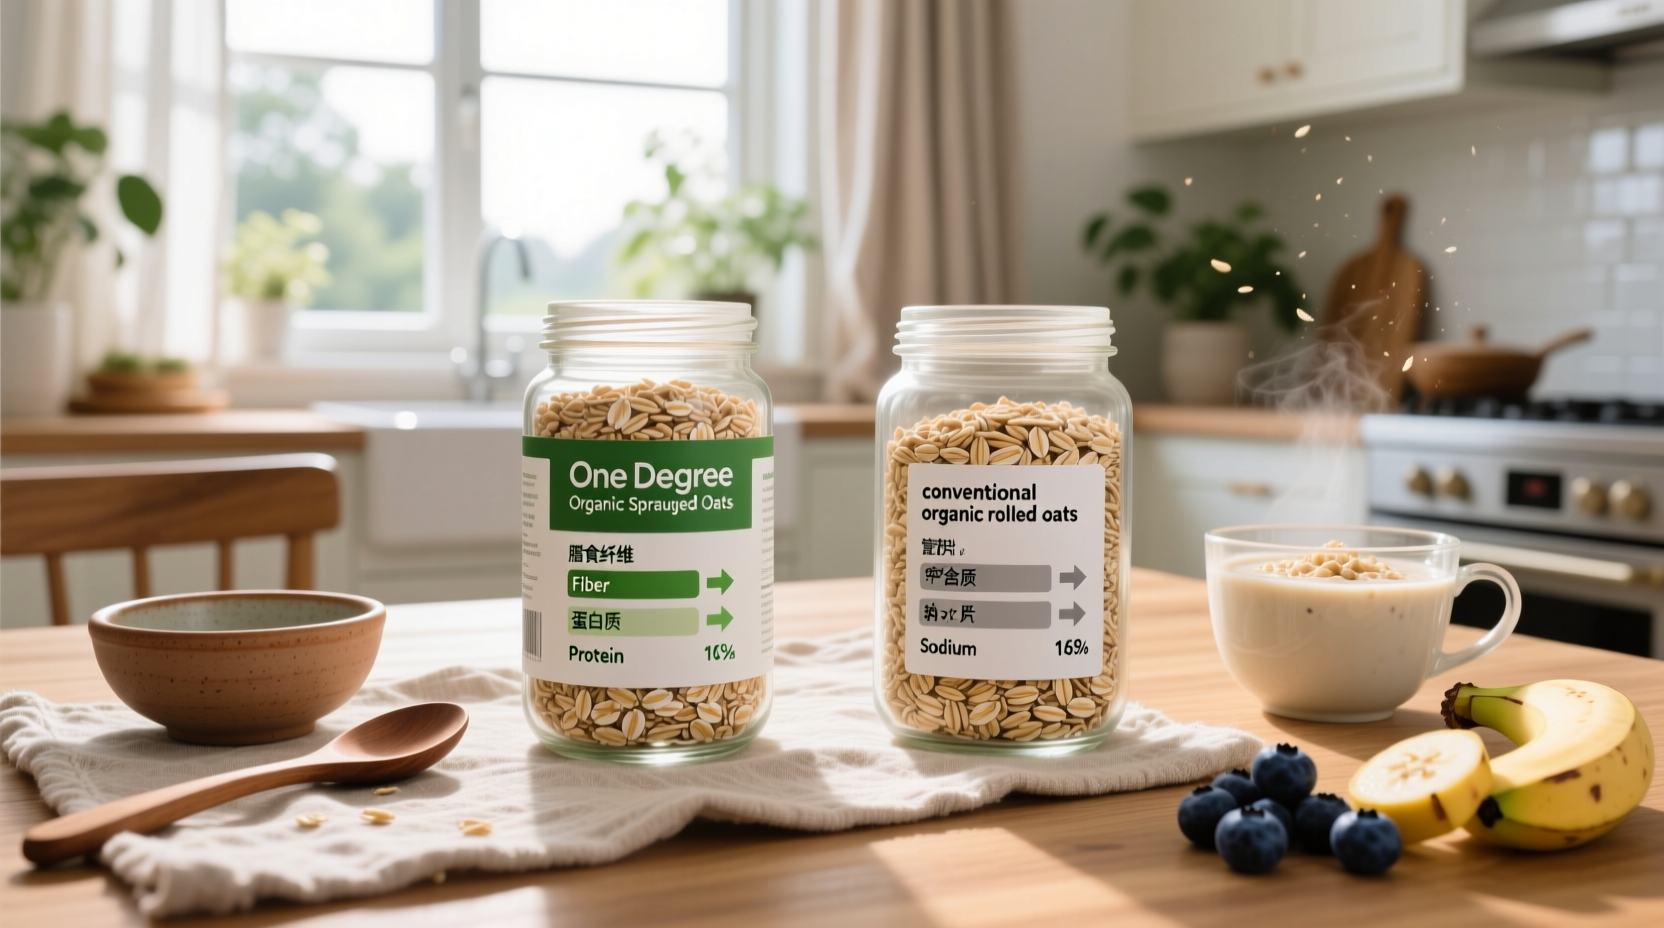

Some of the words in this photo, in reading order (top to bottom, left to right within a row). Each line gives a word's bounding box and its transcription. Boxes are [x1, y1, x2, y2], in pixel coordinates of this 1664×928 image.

[569, 461, 627, 489] One
[634, 462, 733, 495] Degree
[922, 483, 1037, 501] conventional
[569, 495, 625, 515] Organic
[701, 495, 734, 511] Oats
[922, 506, 984, 525] organic
[988, 505, 1037, 522] rolled
[1042, 506, 1078, 522] oats
[572, 576, 611, 593] Fiber
[569, 645, 624, 664] Protein
[920, 638, 977, 656] Sodium
